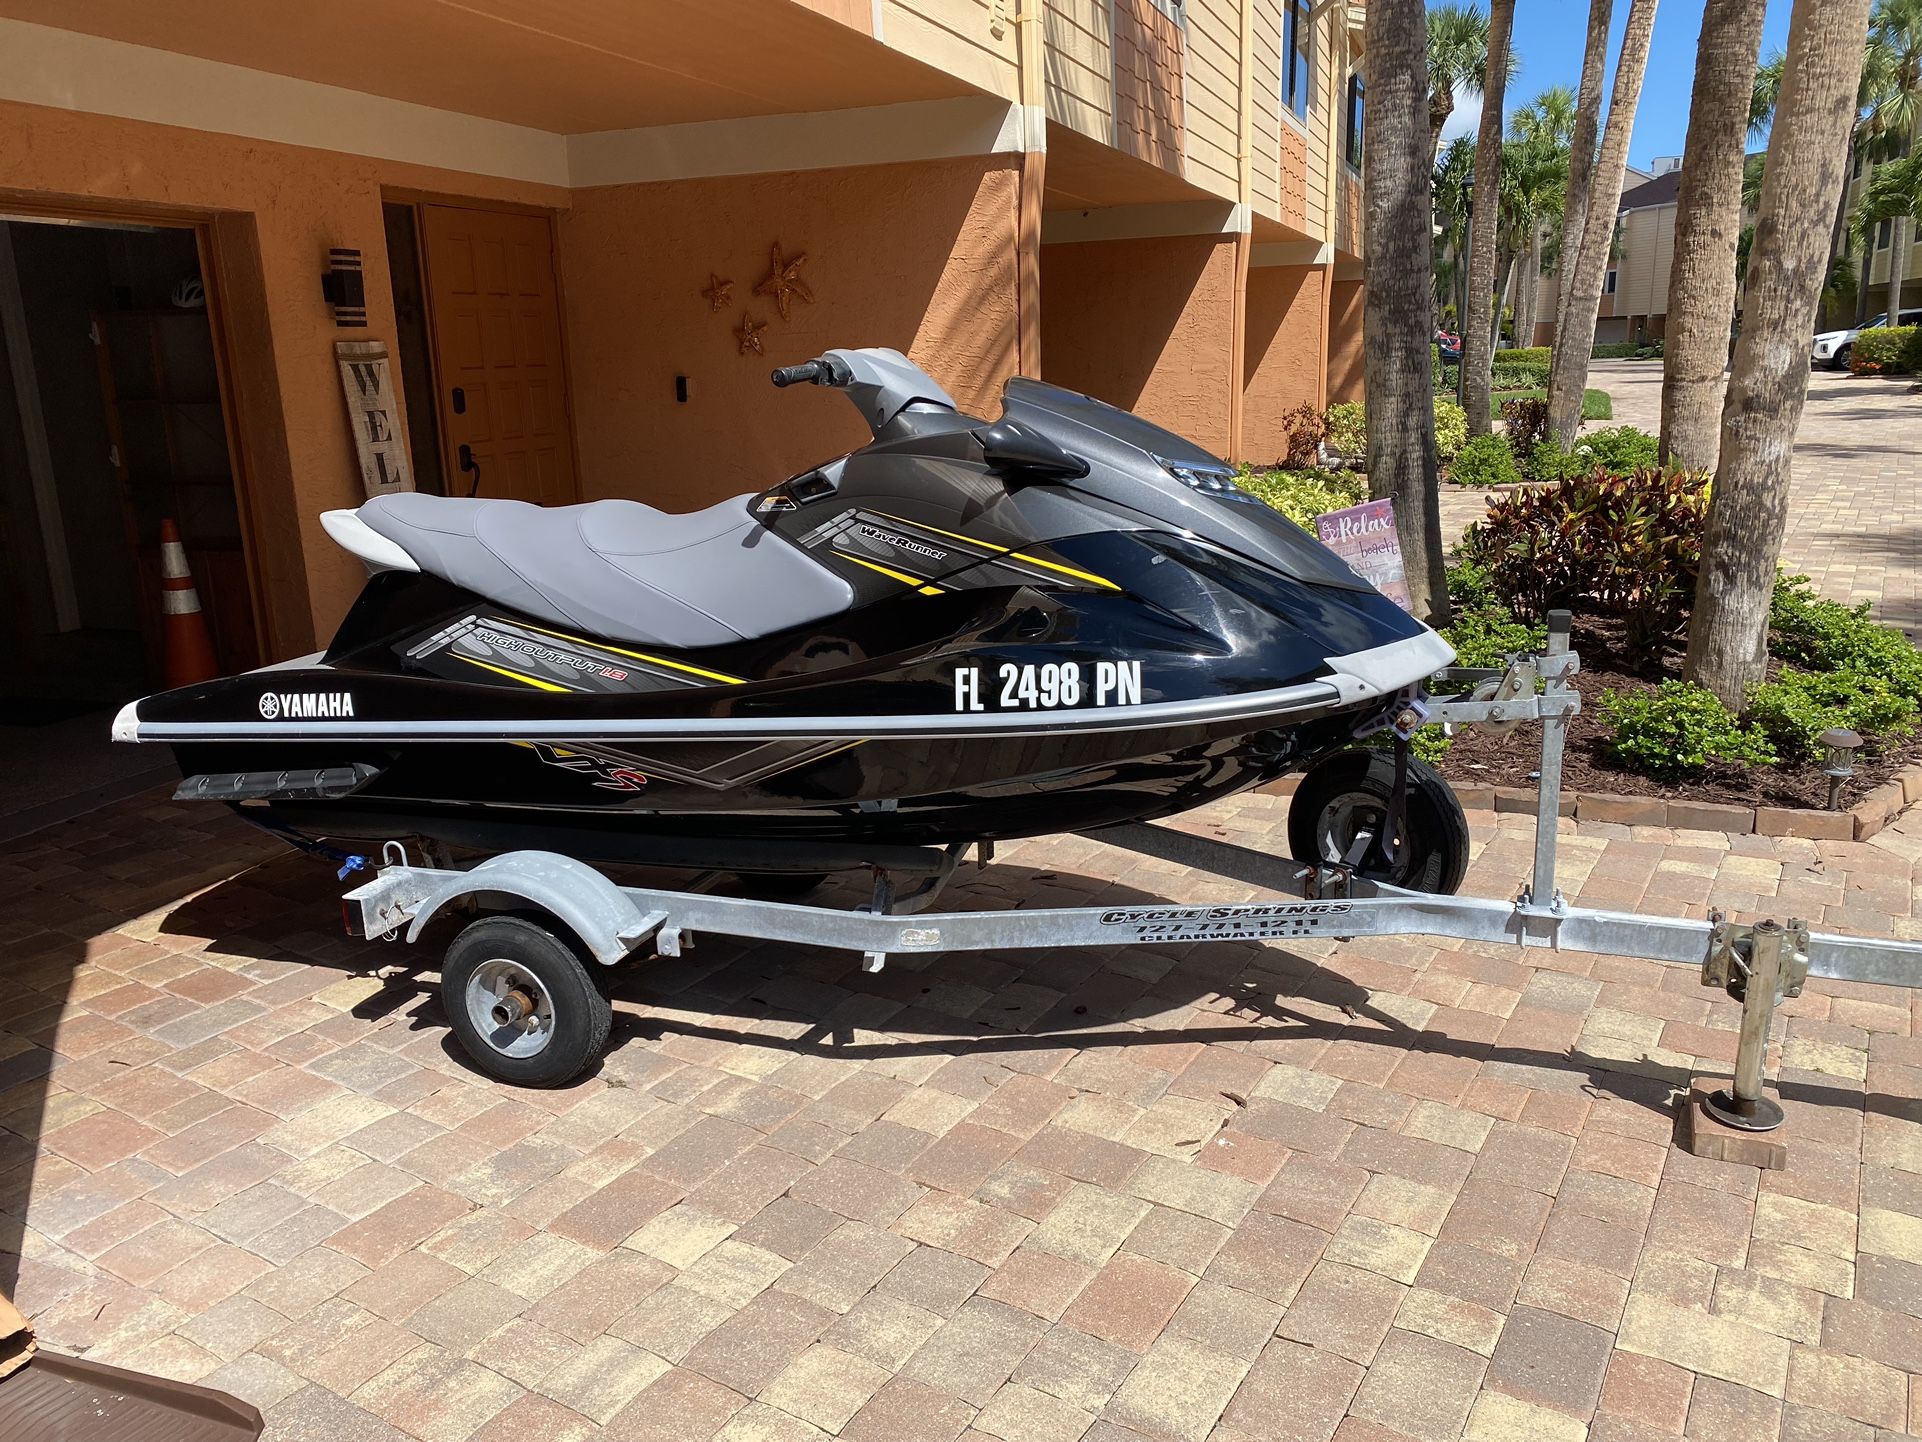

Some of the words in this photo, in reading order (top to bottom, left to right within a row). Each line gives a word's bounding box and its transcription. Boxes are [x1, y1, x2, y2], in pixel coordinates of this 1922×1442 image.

[349, 363, 401, 484] WEL
[1339, 513, 1392, 542] Relax
[860, 525, 947, 560] WaveRunner
[1359, 537, 1398, 558] beach
[955, 667, 984, 711] FL
[999, 662, 1080, 708] 2498
[1096, 660, 1142, 705] PN
[280, 692, 355, 717] YAMAHA
[1100, 907, 1204, 925] CYCLE
[1206, 902, 1354, 920] SPRINGS
[1134, 918, 1319, 933] 727-771-1211
[1139, 930, 1285, 941] CLEARWATER
